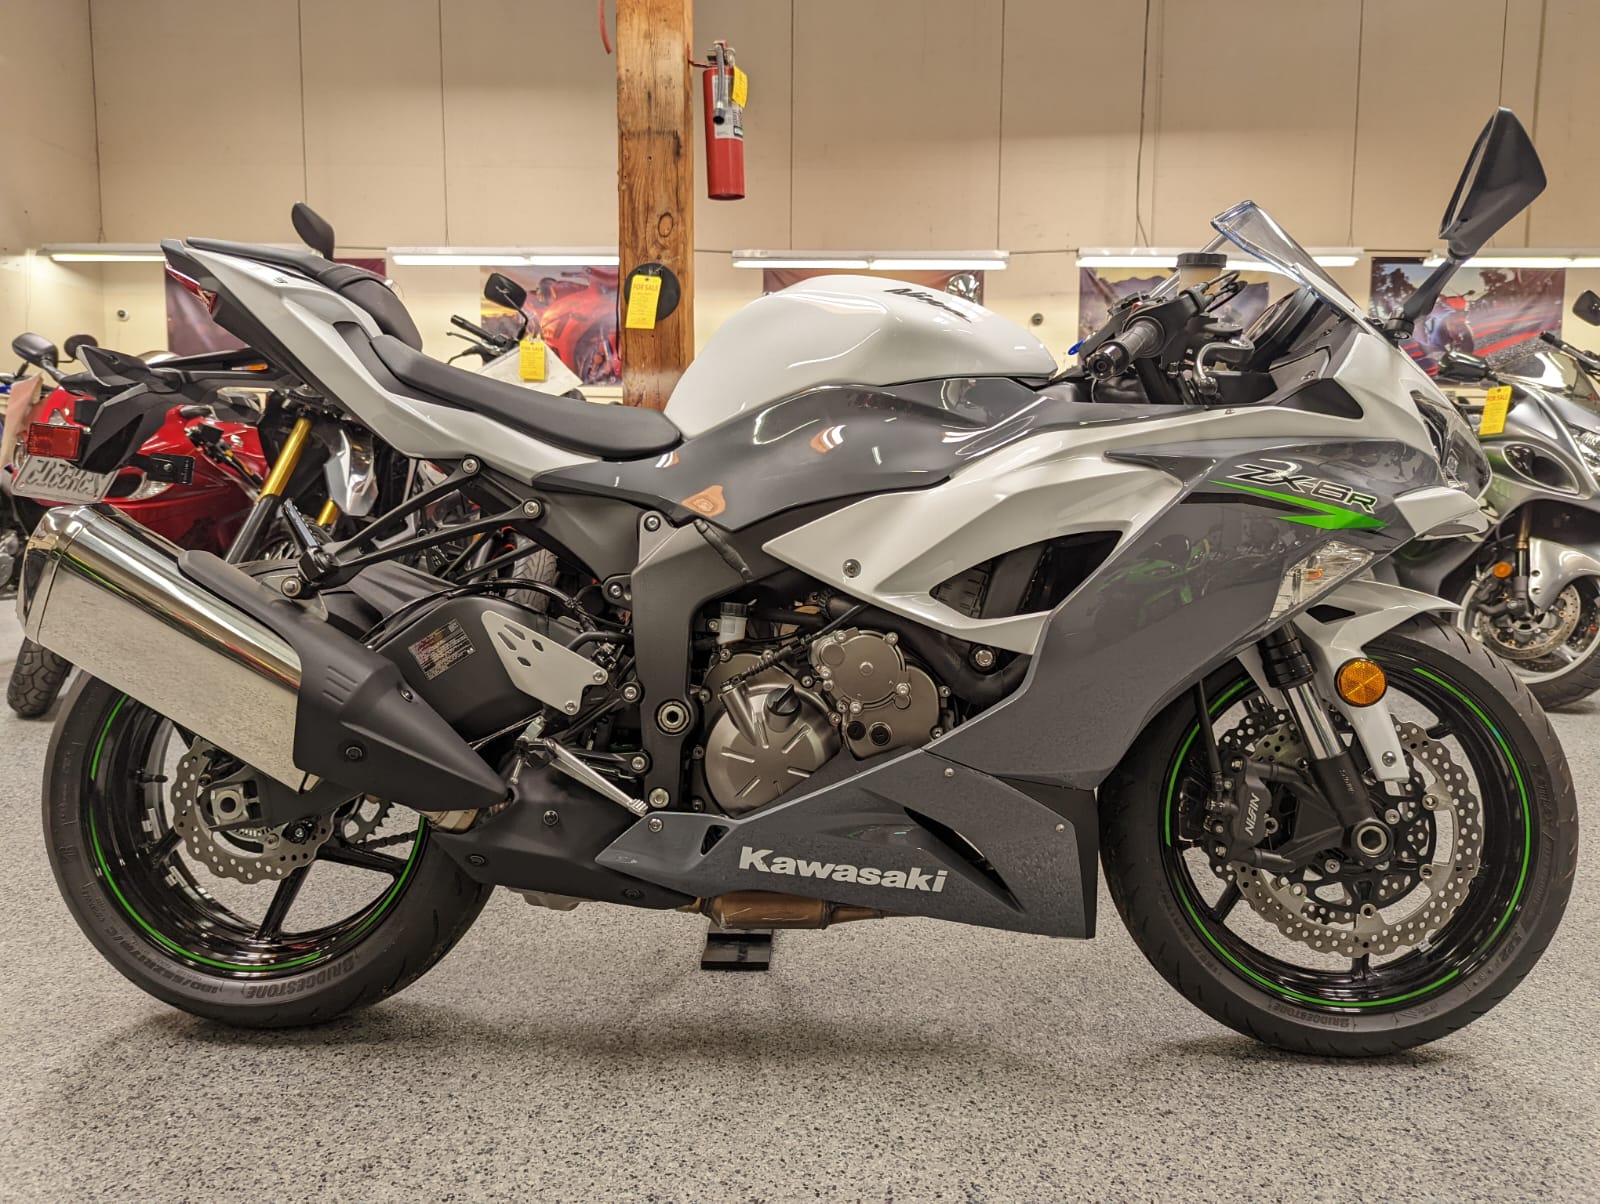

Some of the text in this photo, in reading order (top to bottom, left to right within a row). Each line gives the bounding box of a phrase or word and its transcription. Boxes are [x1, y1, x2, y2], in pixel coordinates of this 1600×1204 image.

[1226, 460, 1378, 514] ZX-6R
[1245, 792, 1260, 837] NISSIN
[738, 846, 949, 893] Kawasaki
[247, 957, 356, 999] BRIDGESTONE
[1271, 1002, 1350, 1028] BRIDGESTONE
